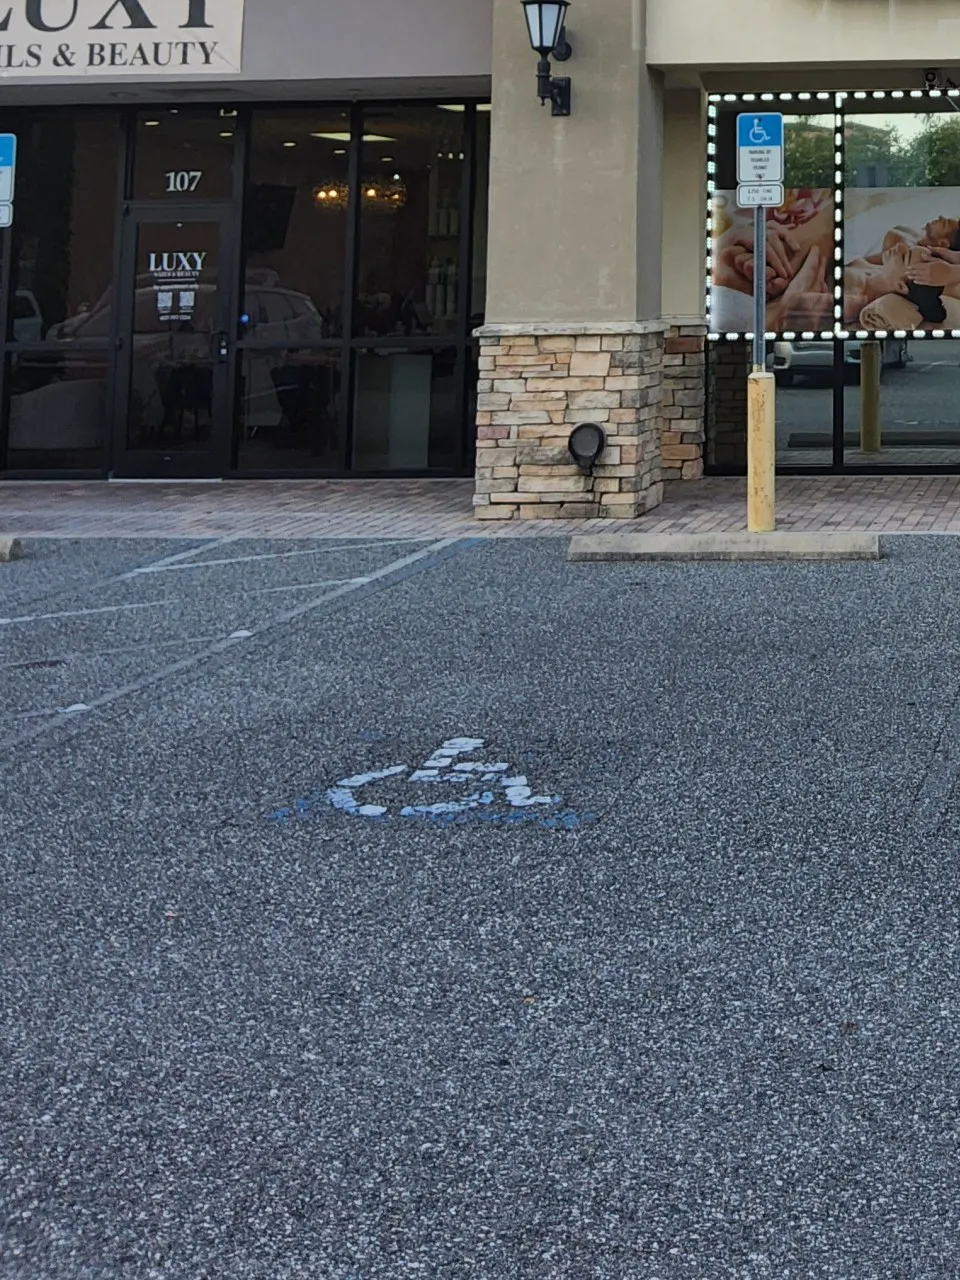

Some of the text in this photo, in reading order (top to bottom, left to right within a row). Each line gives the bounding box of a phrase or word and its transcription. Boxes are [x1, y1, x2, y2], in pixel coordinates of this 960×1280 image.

[52, 42, 76, 67] &
[86, 40, 219, 66] BEAUTY
[165, 171, 203, 192] 107
[149, 252, 207, 271] LUXY
